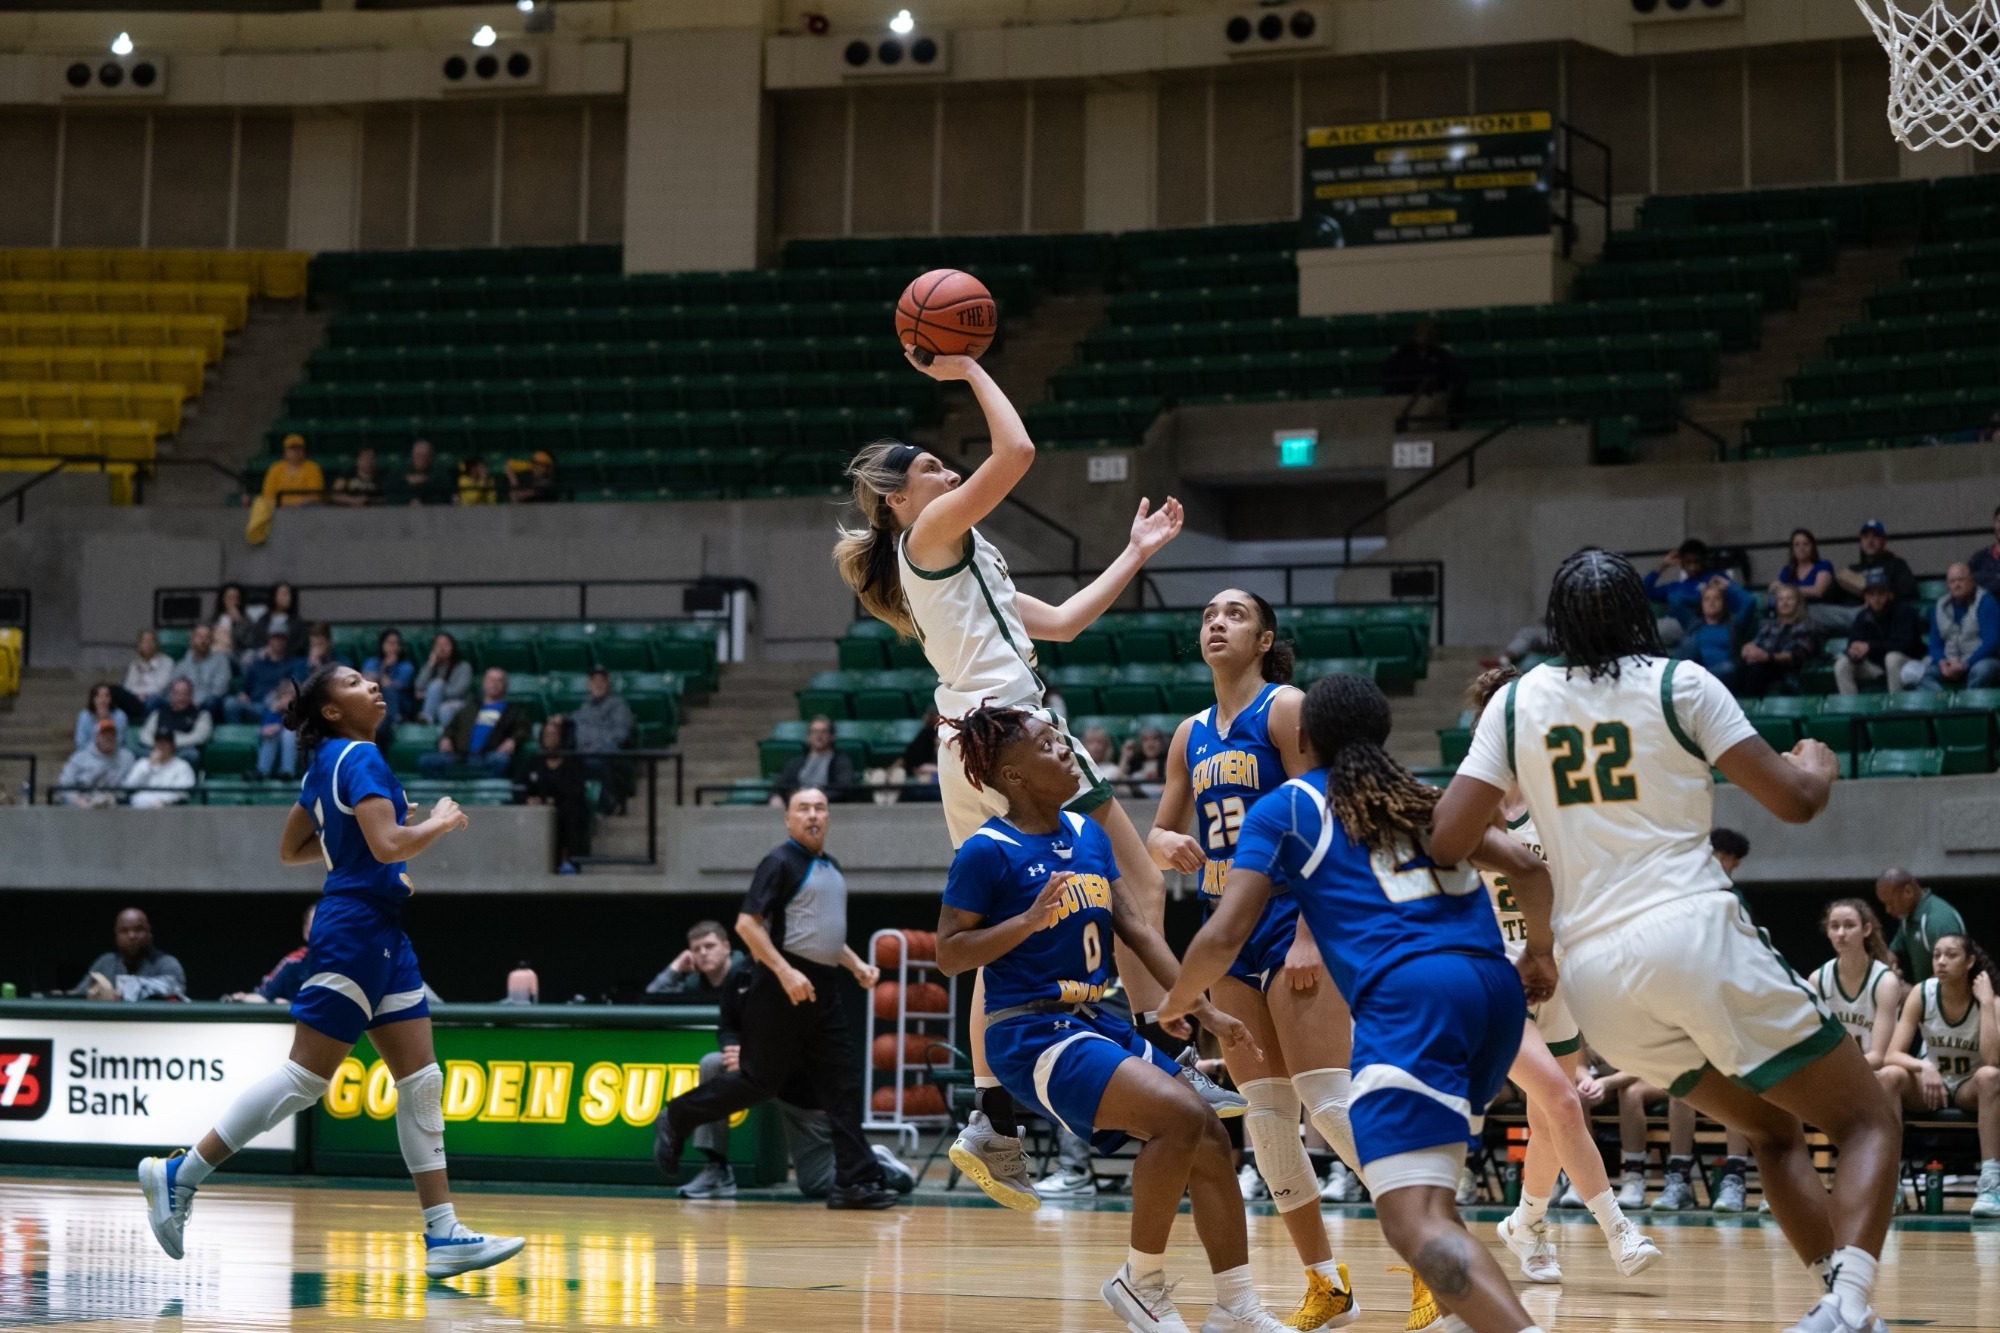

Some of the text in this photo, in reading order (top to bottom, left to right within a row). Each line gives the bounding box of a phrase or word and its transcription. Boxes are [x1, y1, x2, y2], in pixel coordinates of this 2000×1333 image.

[957, 306, 984, 327] THE
[1192, 750, 1260, 802] SOUTHERN
[1544, 720, 1639, 808] 22
[1083, 920, 1102, 974] 0
[68, 1049, 225, 1082] Simmons
[68, 1085, 150, 1116] Bank
[324, 1056, 574, 1124] GODEN
[1927, 1174, 1938, 1189] G
